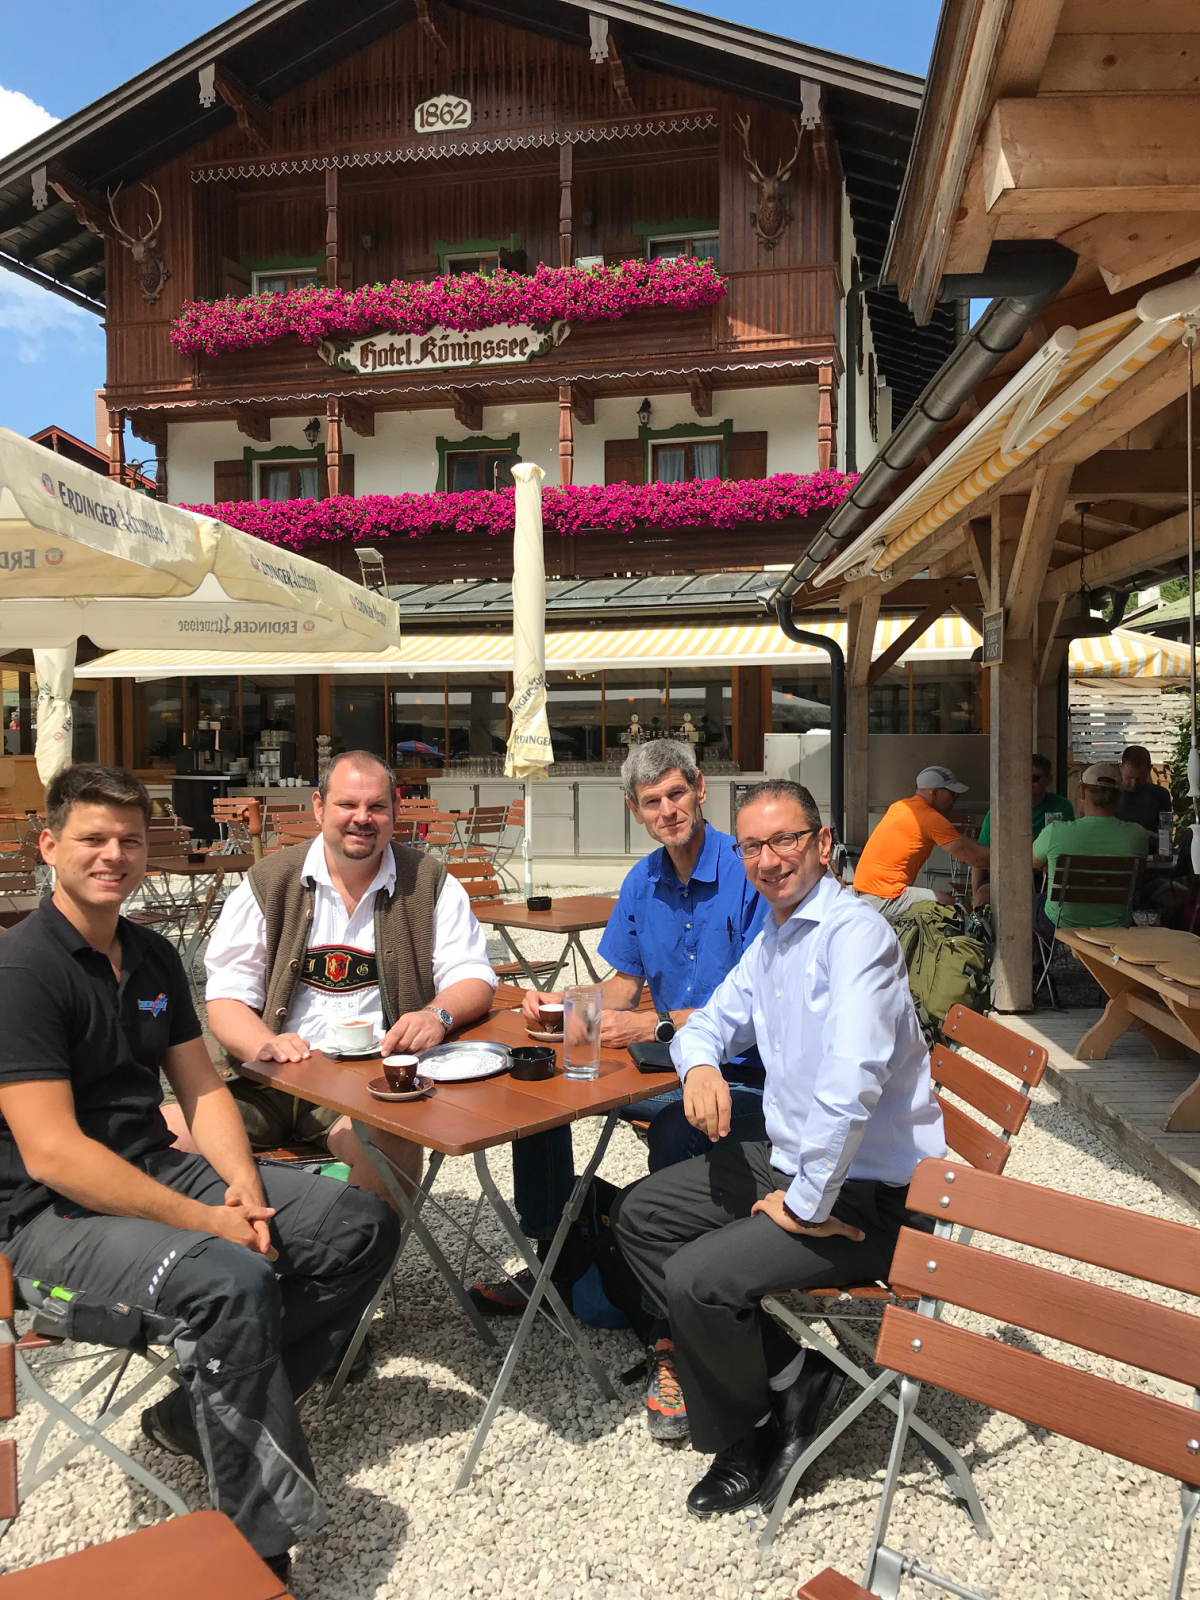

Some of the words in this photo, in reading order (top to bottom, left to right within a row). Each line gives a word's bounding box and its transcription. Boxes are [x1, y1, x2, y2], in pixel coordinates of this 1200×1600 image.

[417, 100, 468, 129] 1862
[360, 338, 413, 371] Hotel
[414, 333, 530, 365] Königssee
[58, 481, 121, 530] ERDINGER
